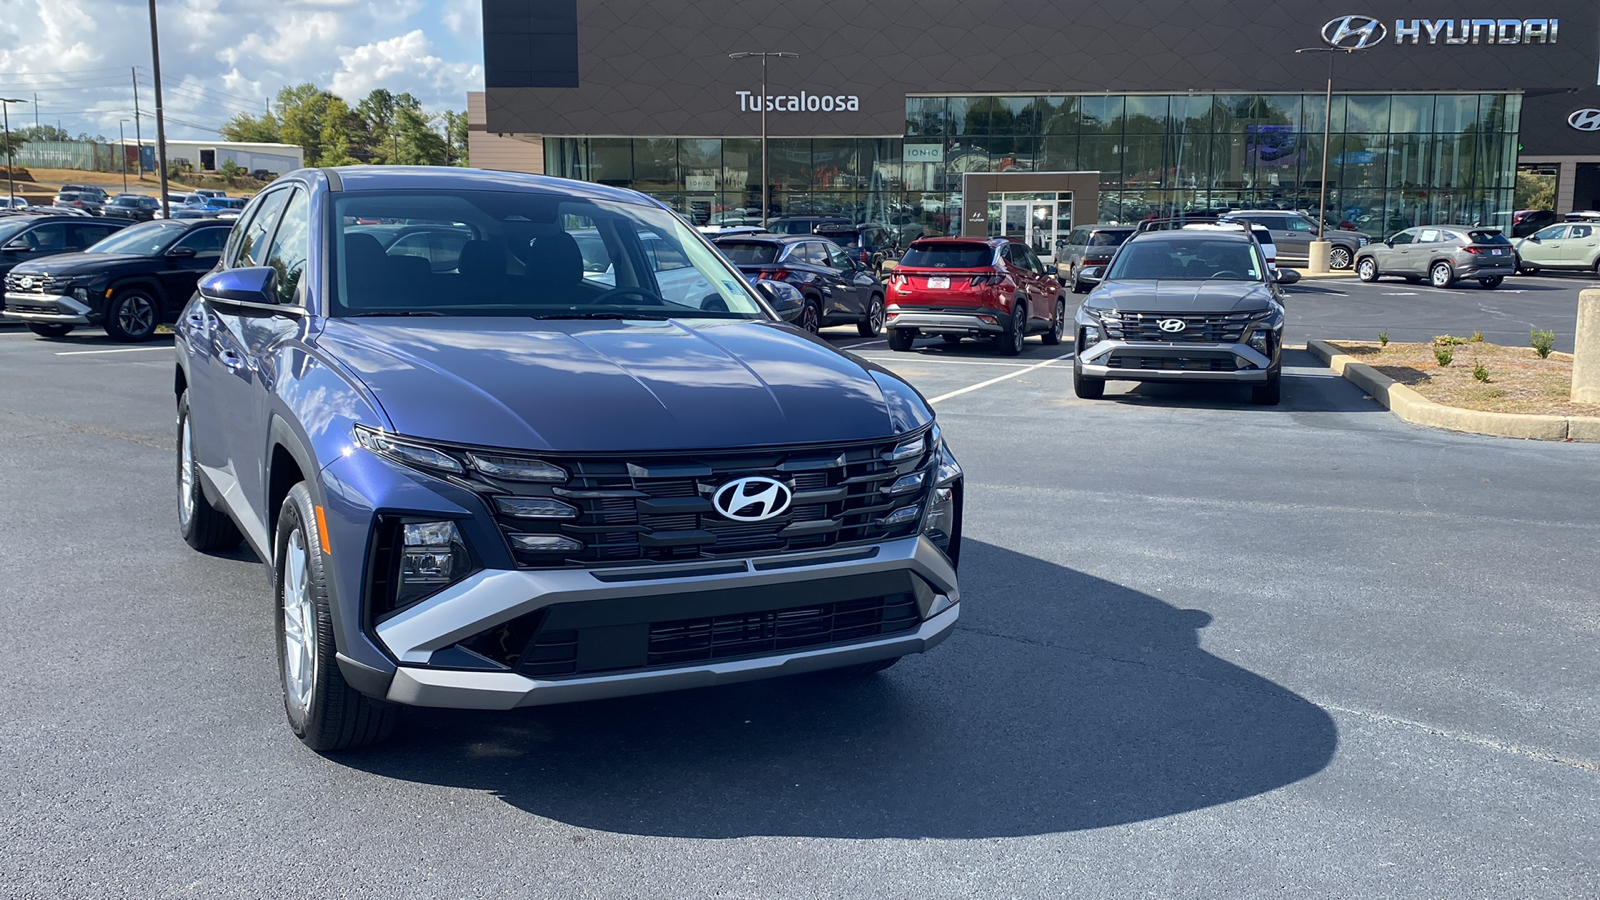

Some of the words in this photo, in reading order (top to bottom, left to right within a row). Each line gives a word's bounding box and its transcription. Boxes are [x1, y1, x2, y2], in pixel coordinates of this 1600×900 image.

[1394, 18, 1559, 45] HYUNDAI
[735, 90, 860, 112] Tuscaloosa
[907, 148, 940, 158] IONIQ
